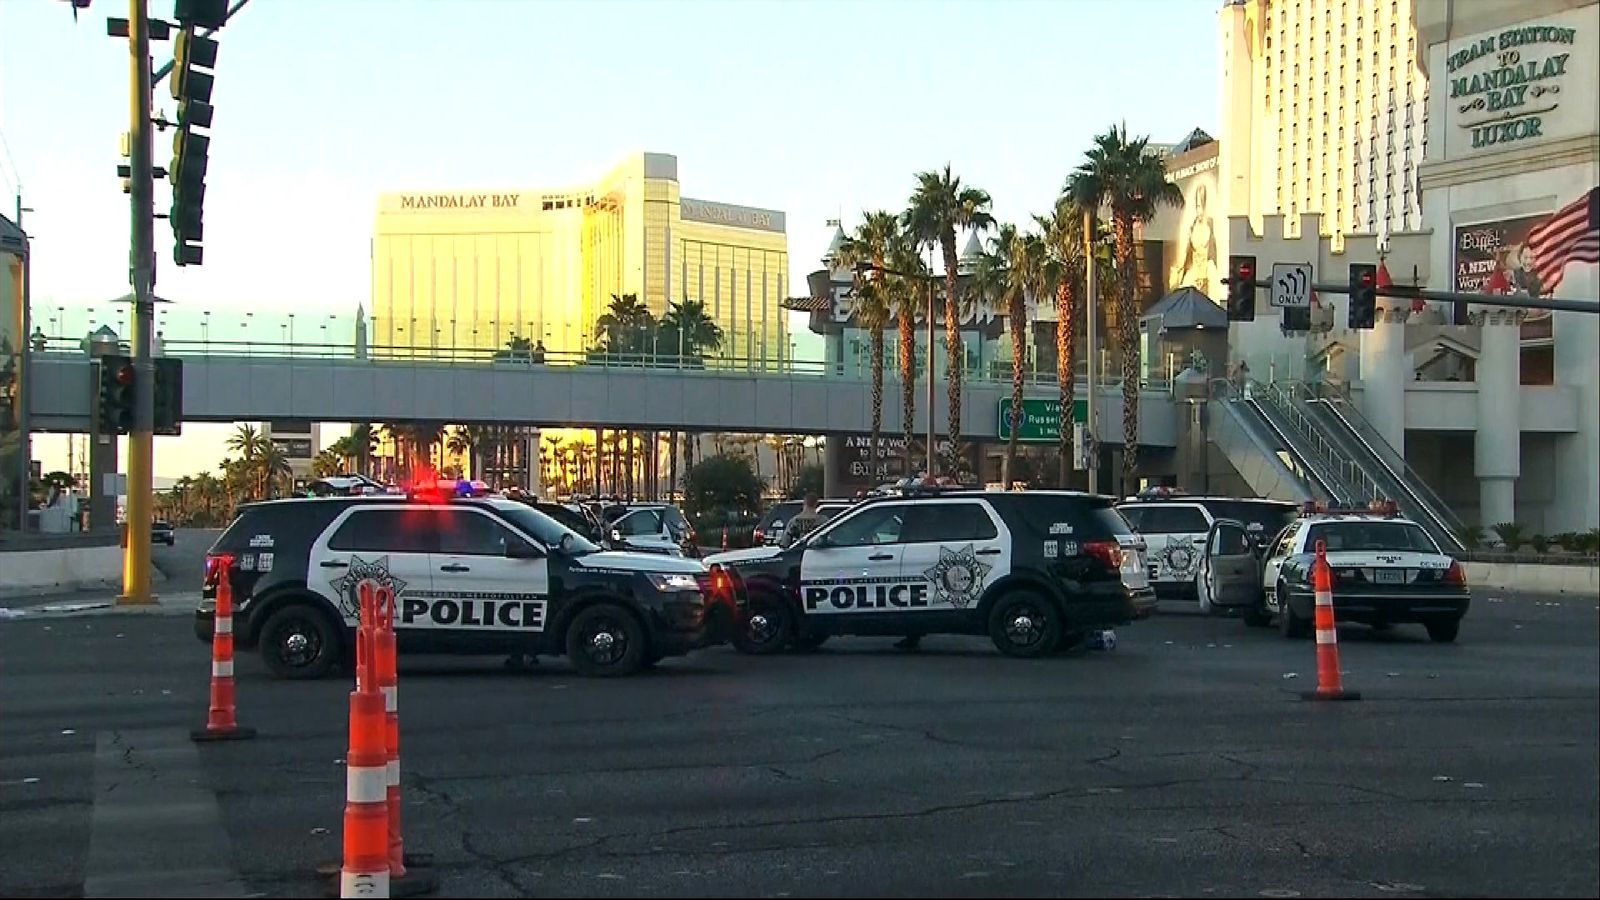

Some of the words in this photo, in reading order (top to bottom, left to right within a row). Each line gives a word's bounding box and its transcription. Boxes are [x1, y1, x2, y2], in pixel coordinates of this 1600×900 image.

[1447, 36, 1495, 73] TRAM
[1500, 26, 1577, 50] STATION
[1497, 50, 1520, 67] TO
[1450, 53, 1570, 98] MANDALAY
[1486, 84, 1529, 112] BAY
[1472, 116, 1543, 148] LUXOR
[401, 194, 487, 208] MANDALAY
[492, 194, 520, 208] BAY
[752, 212, 772, 227] BAY
[1462, 230, 1501, 251] Buffet
[1458, 262, 1467, 275] A
[1469, 260, 1497, 274] NEW
[1458, 276, 1480, 290] Way
[1279, 295, 1303, 303] ONLY
[845, 436, 855, 448] A
[852, 460, 888, 476] Buet
[806, 584, 928, 610] POLICE
[402, 599, 543, 627] POLICE
